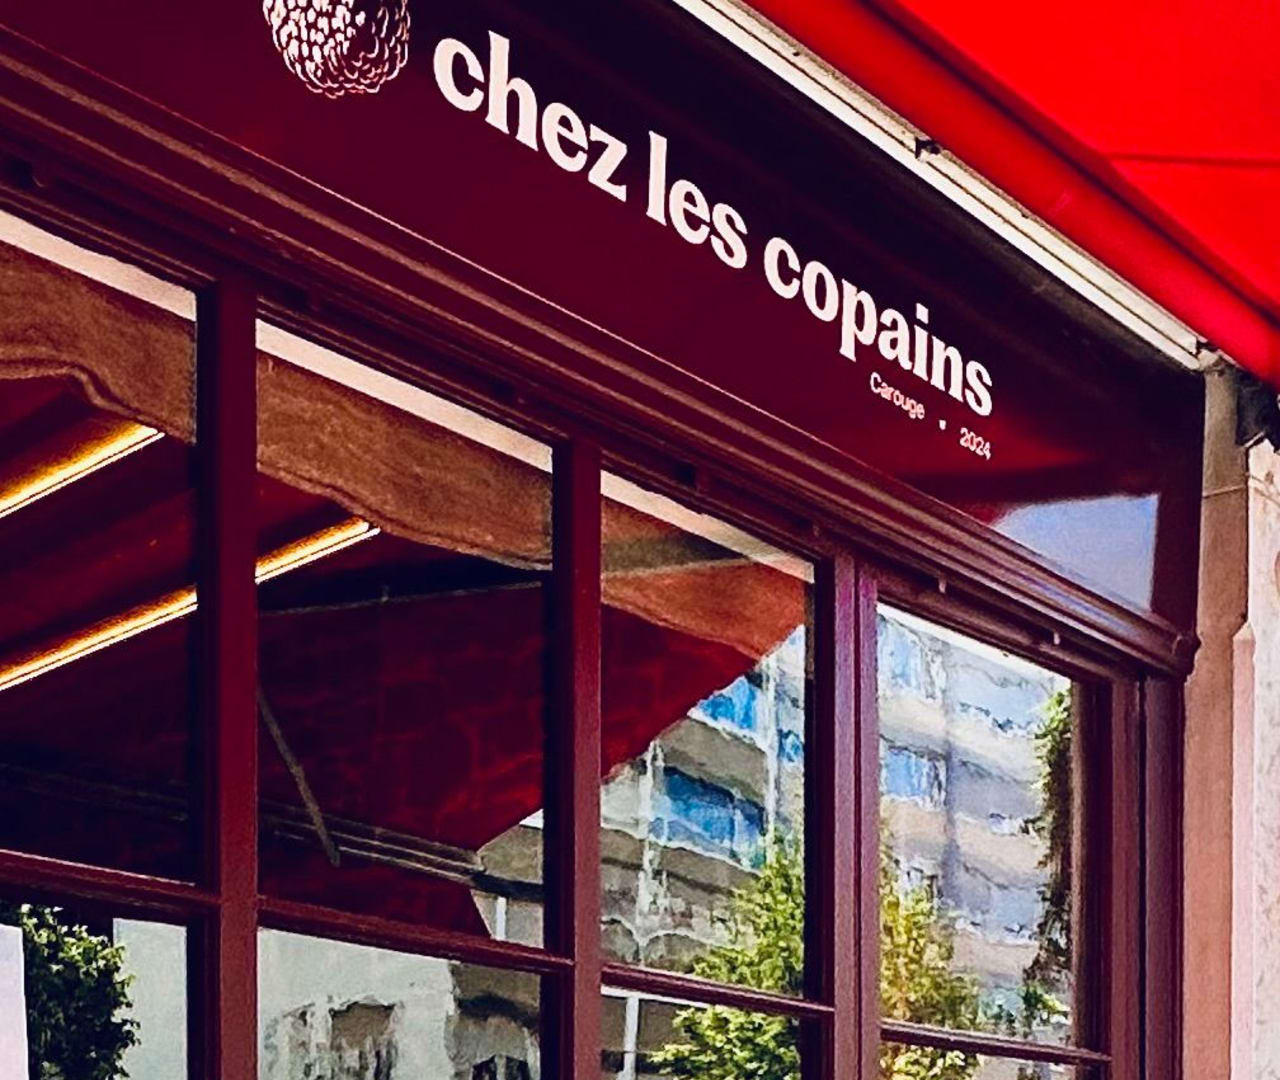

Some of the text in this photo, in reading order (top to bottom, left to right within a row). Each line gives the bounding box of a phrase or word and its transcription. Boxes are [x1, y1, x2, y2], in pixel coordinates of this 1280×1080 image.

[432, 30, 994, 417] chez les copains
[869, 371, 992, 461] Carouge 2024
